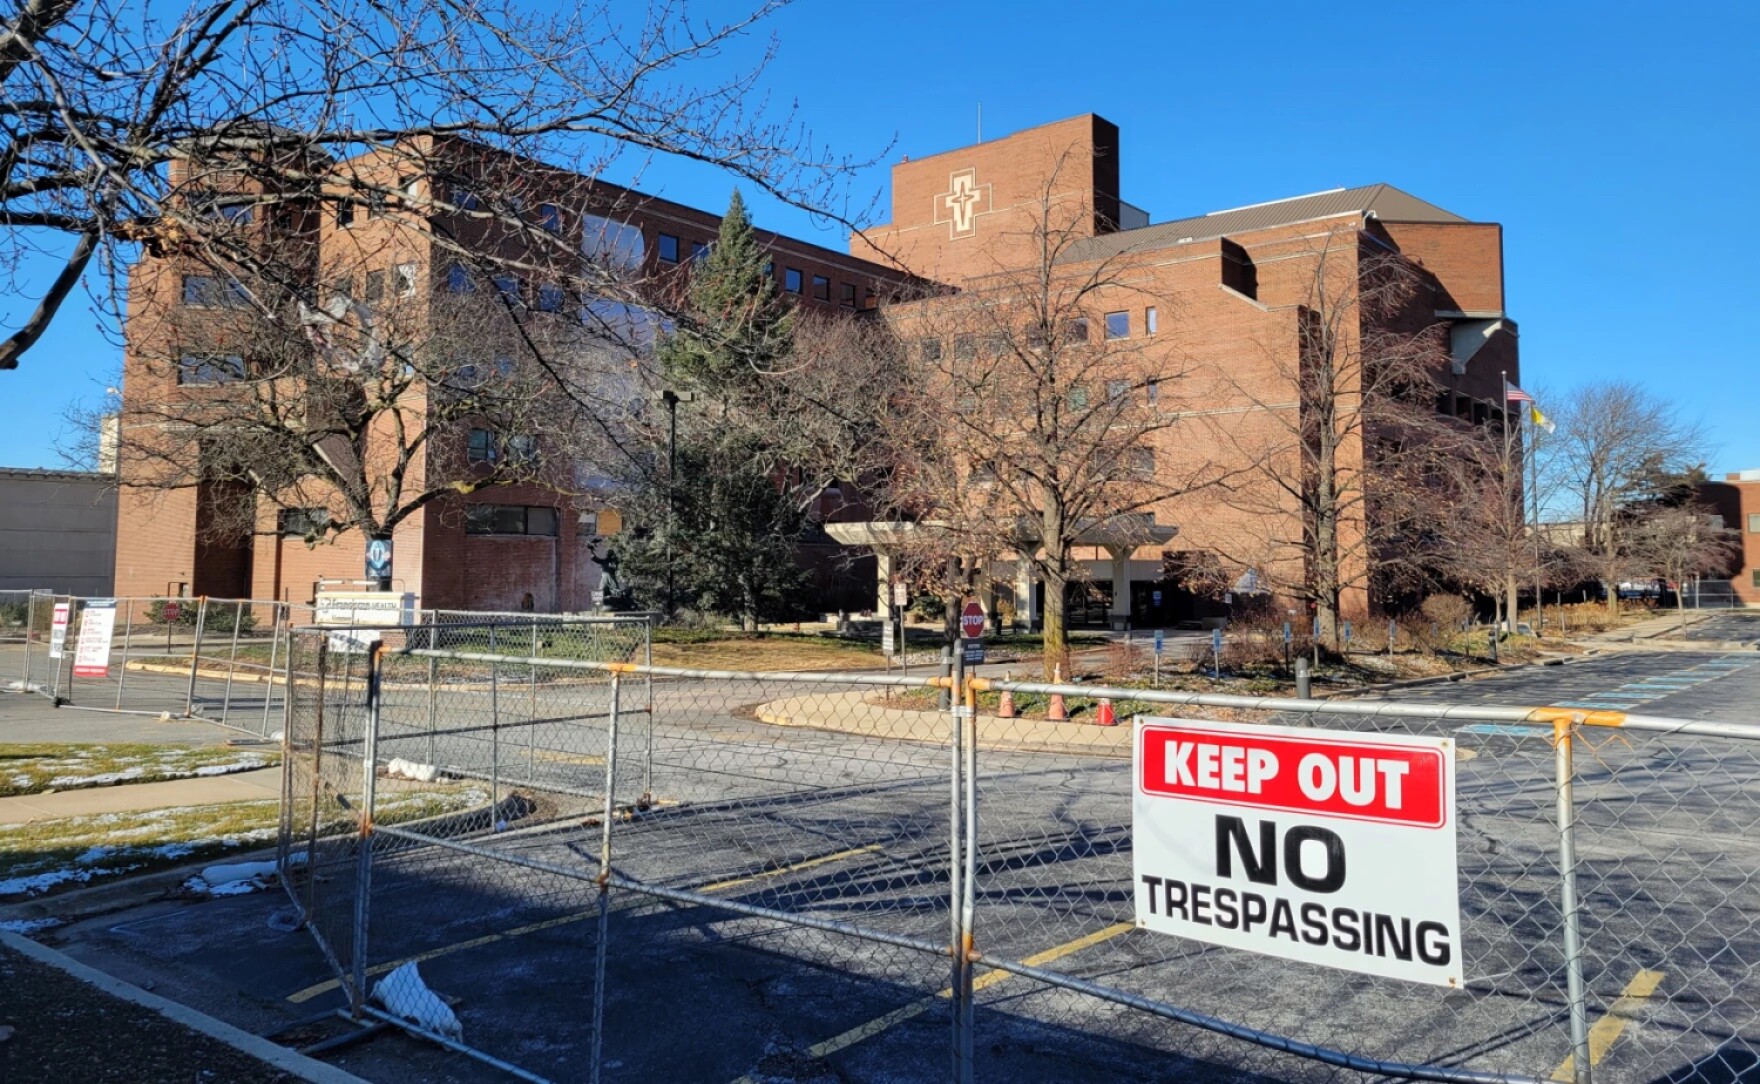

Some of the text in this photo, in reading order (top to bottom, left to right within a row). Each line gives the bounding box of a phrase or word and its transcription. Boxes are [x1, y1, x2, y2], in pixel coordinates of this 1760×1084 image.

[963, 615, 984, 626] STOP
[1164, 740, 1410, 810] KEEP OUT
[1215, 813, 1346, 894] NO
[1142, 875, 1451, 966] TRESPASSING
